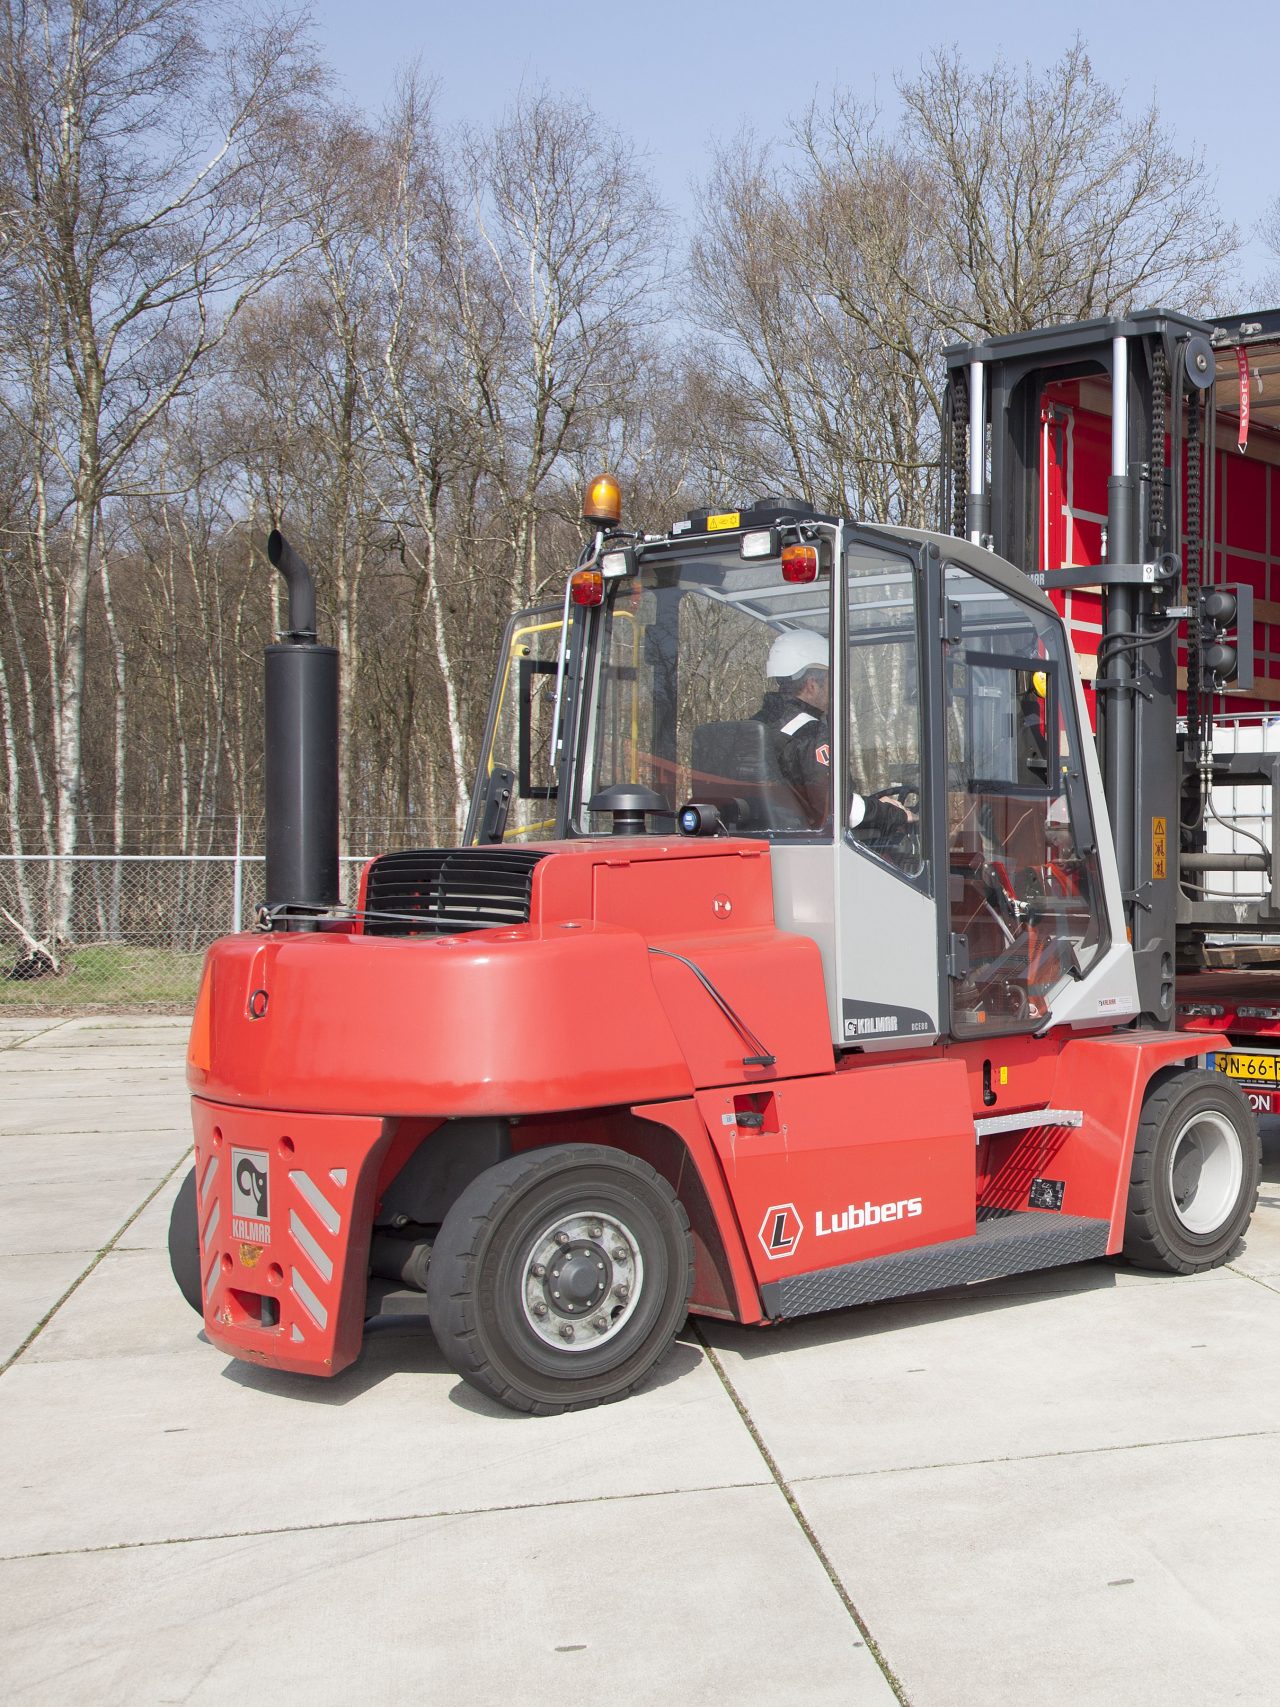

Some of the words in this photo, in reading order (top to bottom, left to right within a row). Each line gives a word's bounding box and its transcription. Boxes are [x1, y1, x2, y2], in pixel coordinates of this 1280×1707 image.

[858, 1015, 898, 1034] KALMAR
[232, 1218, 271, 1244] KALMAR
[770, 1212, 794, 1249] L
[815, 1197, 922, 1237] Lubbers
